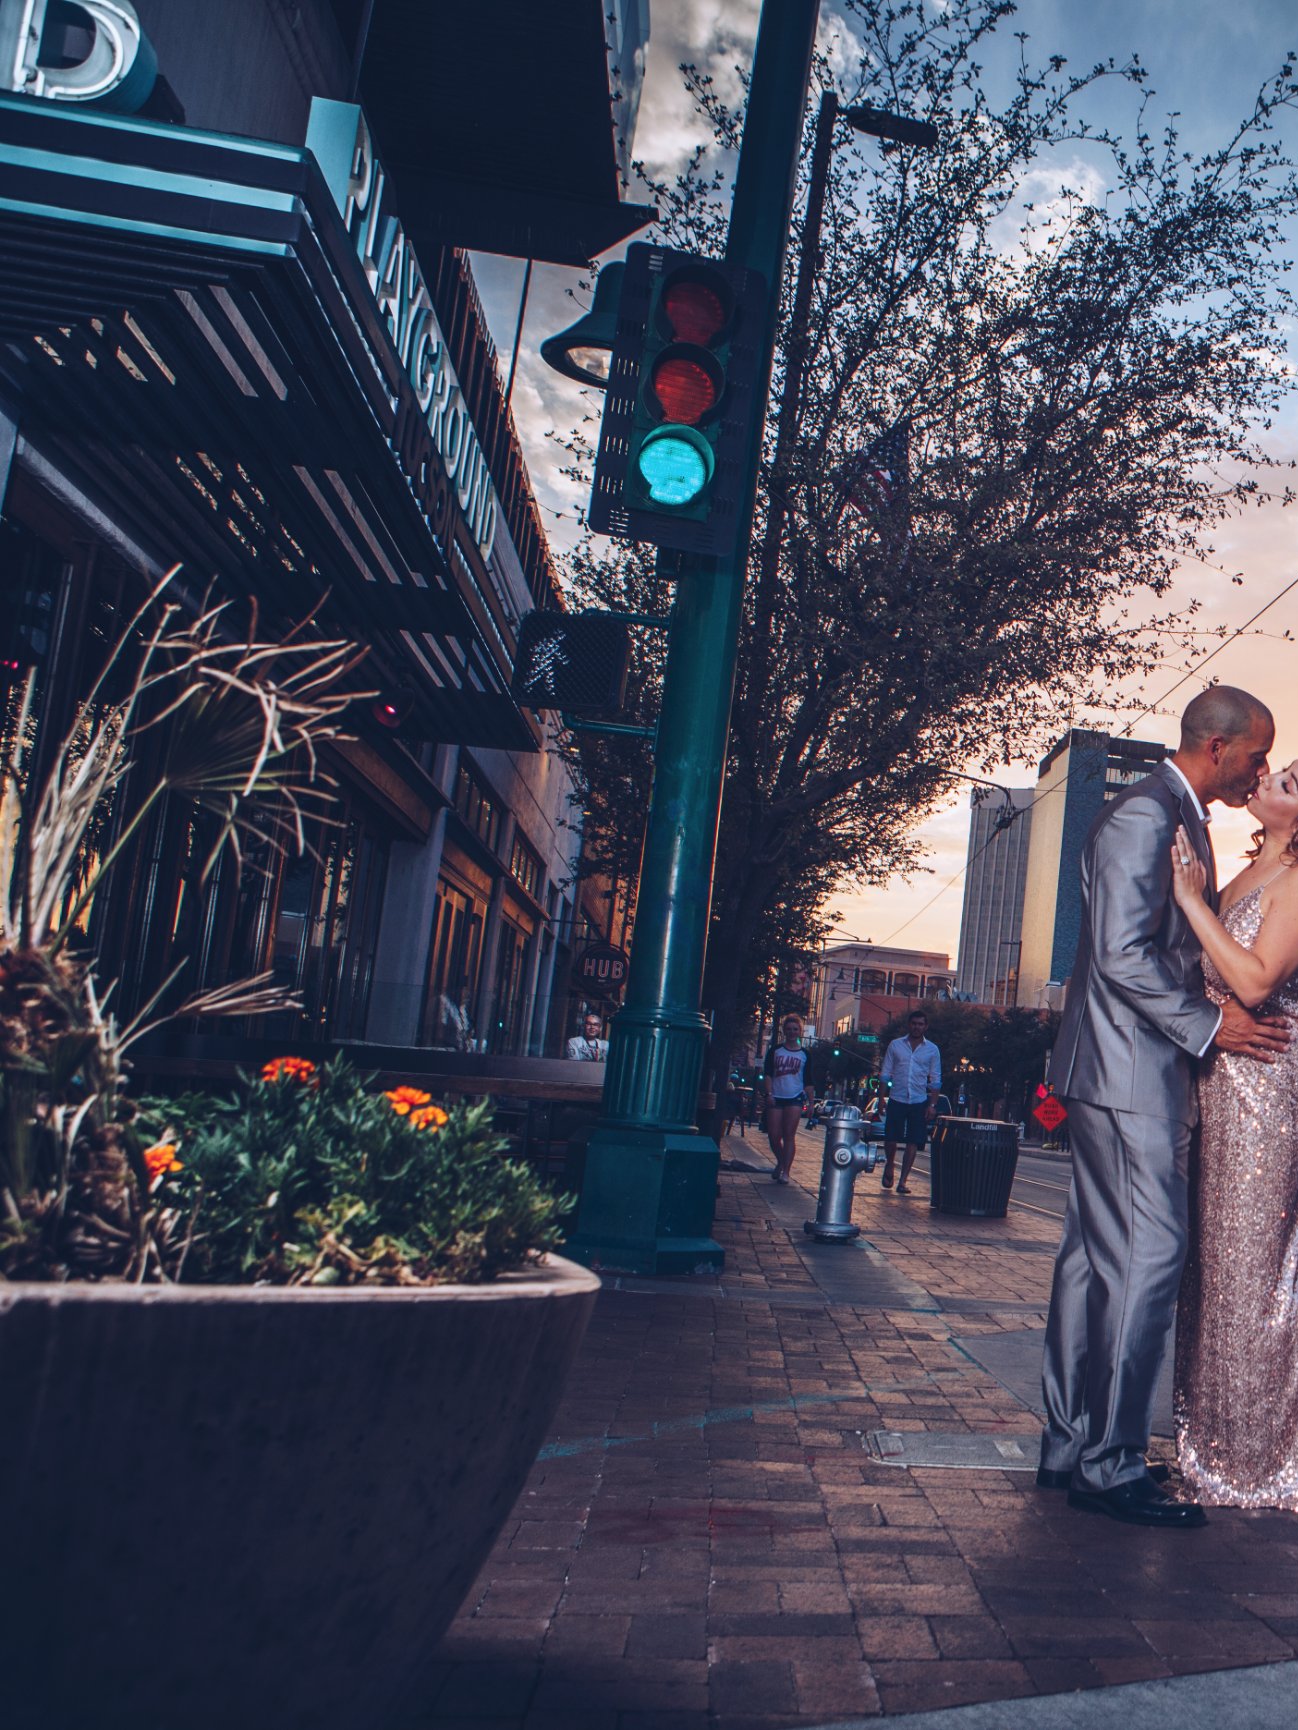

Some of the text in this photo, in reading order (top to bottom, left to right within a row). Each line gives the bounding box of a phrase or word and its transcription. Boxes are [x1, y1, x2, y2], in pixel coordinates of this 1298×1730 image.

[344, 104, 497, 562] PLAYGROUND
[583, 957, 624, 979] HUB
[970, 1122, 998, 1131] Landfill
